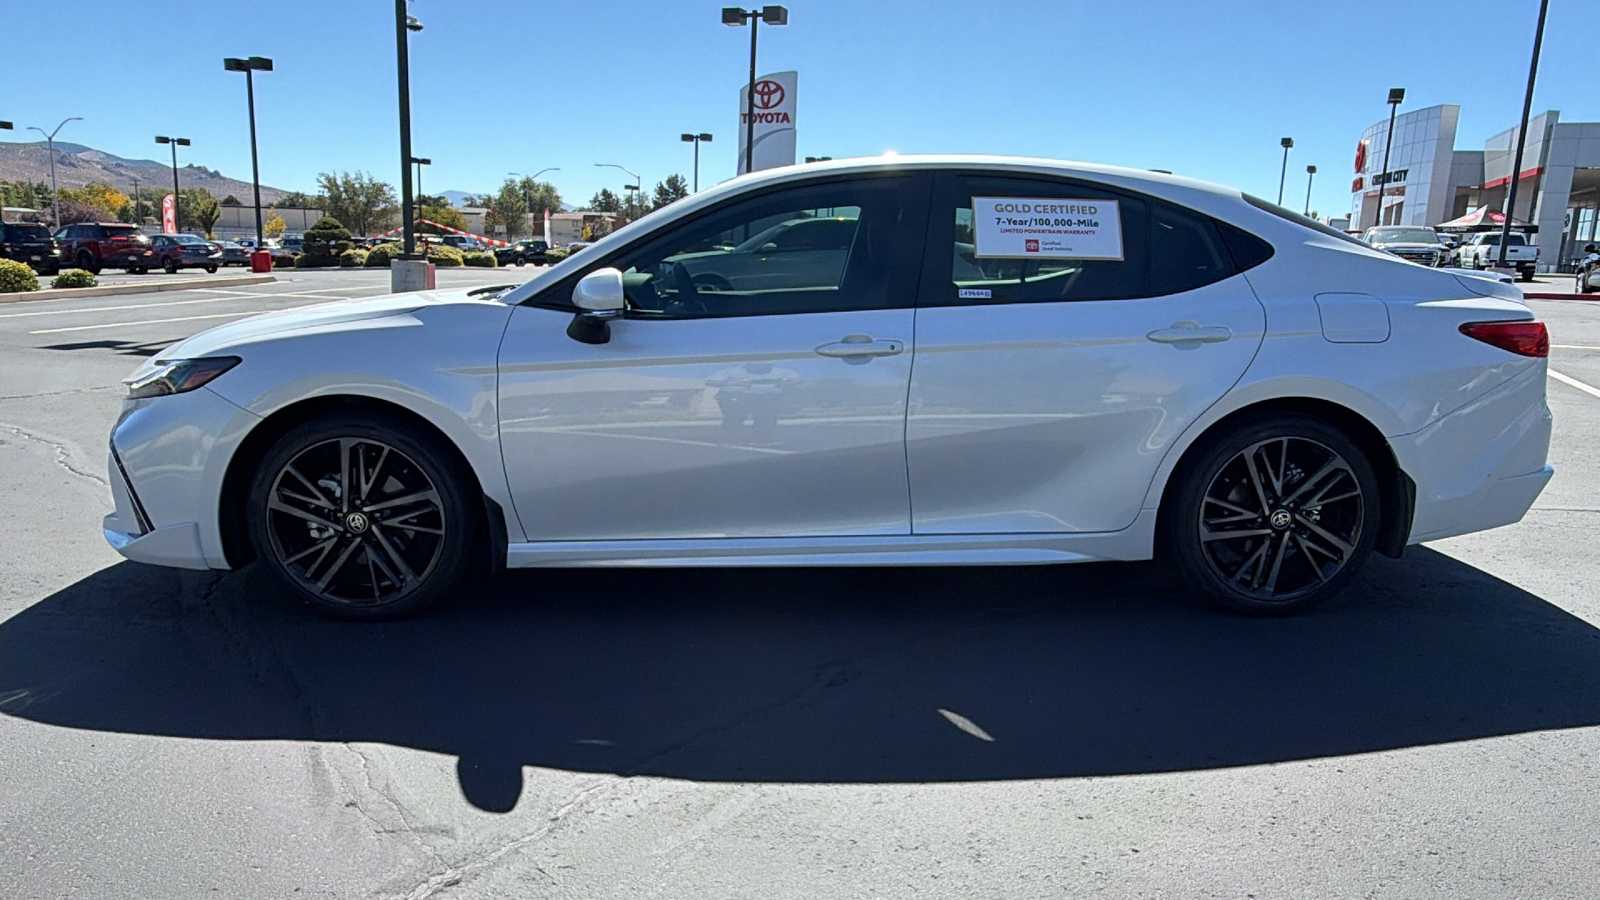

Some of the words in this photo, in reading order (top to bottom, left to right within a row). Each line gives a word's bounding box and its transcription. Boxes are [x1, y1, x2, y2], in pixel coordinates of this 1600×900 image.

[994, 203, 1031, 214] GOLD
[1034, 204, 1098, 215] CERTIFIED
[995, 217, 1099, 228] 7-Year/100,000-Mile
